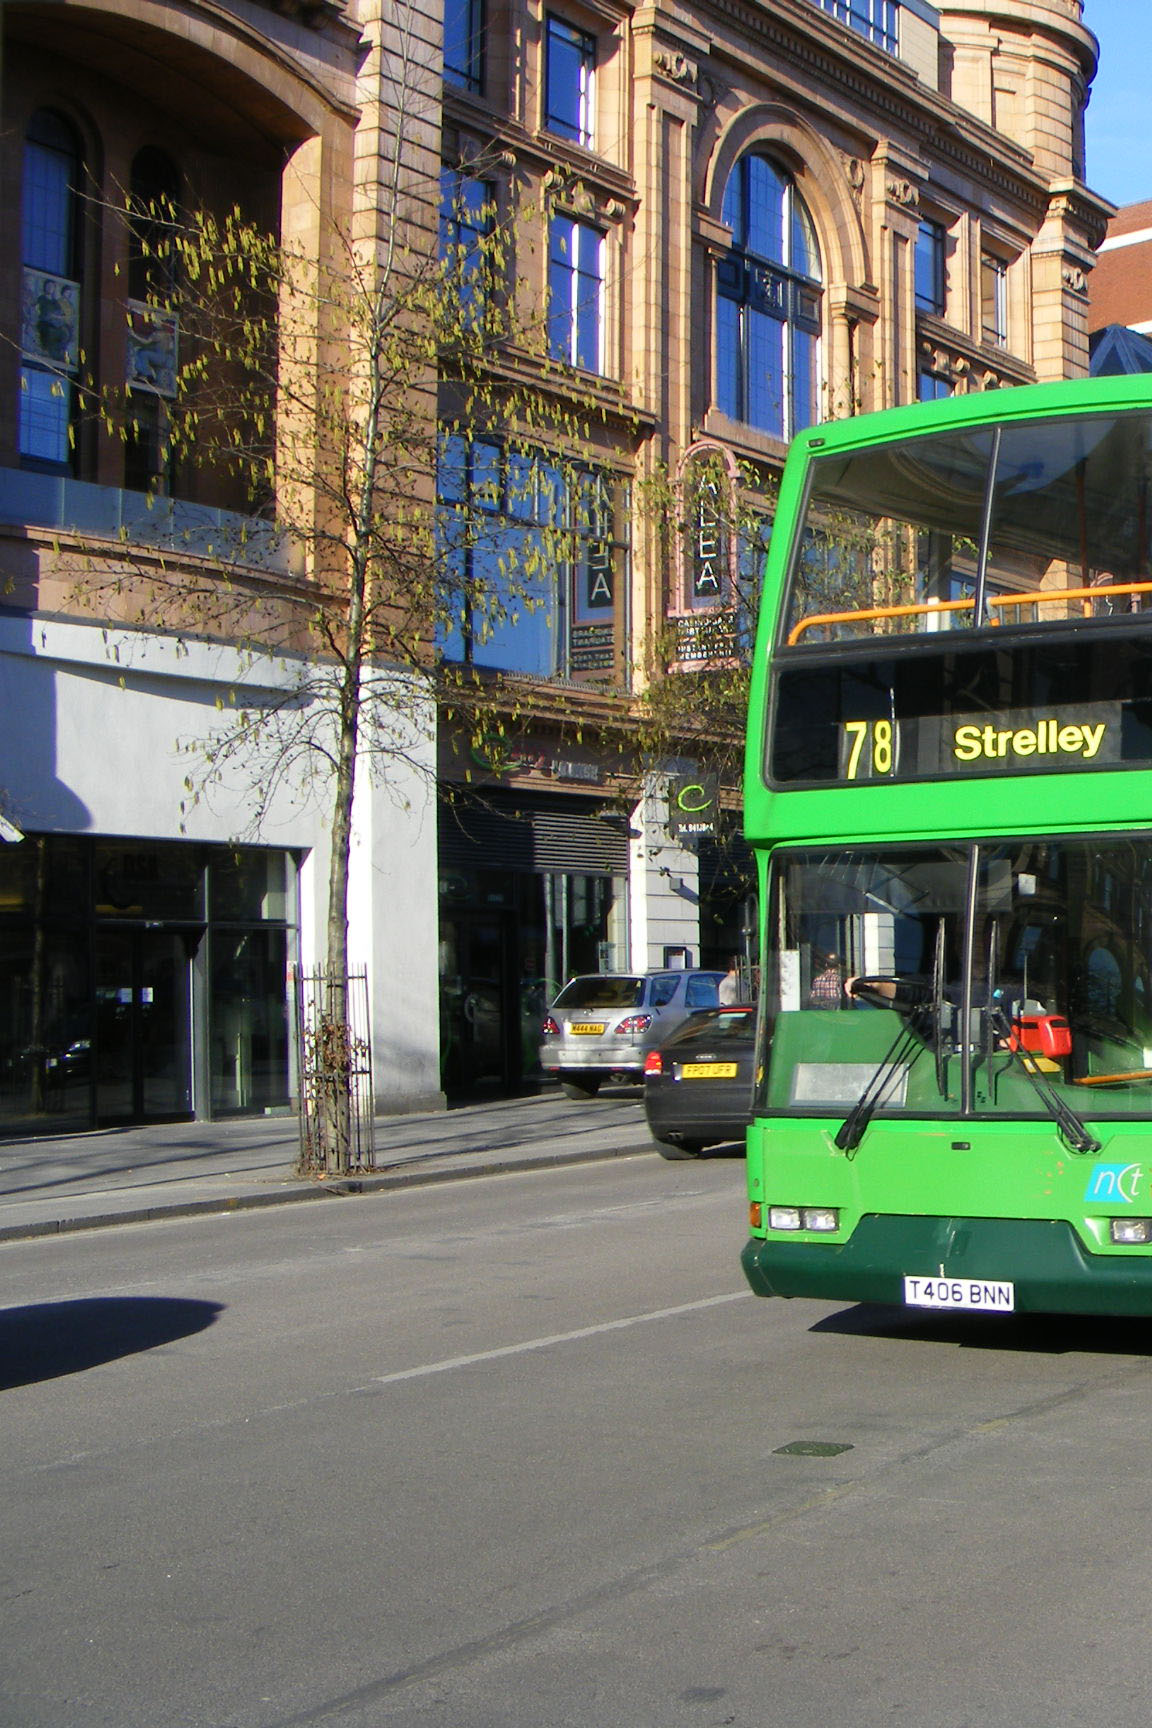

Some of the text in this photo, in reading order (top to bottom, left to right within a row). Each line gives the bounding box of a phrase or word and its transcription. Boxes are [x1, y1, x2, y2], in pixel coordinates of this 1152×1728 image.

[845, 720, 1105, 779] 78 Strelley
[909, 1280, 1010, 1305] T406 BNN
